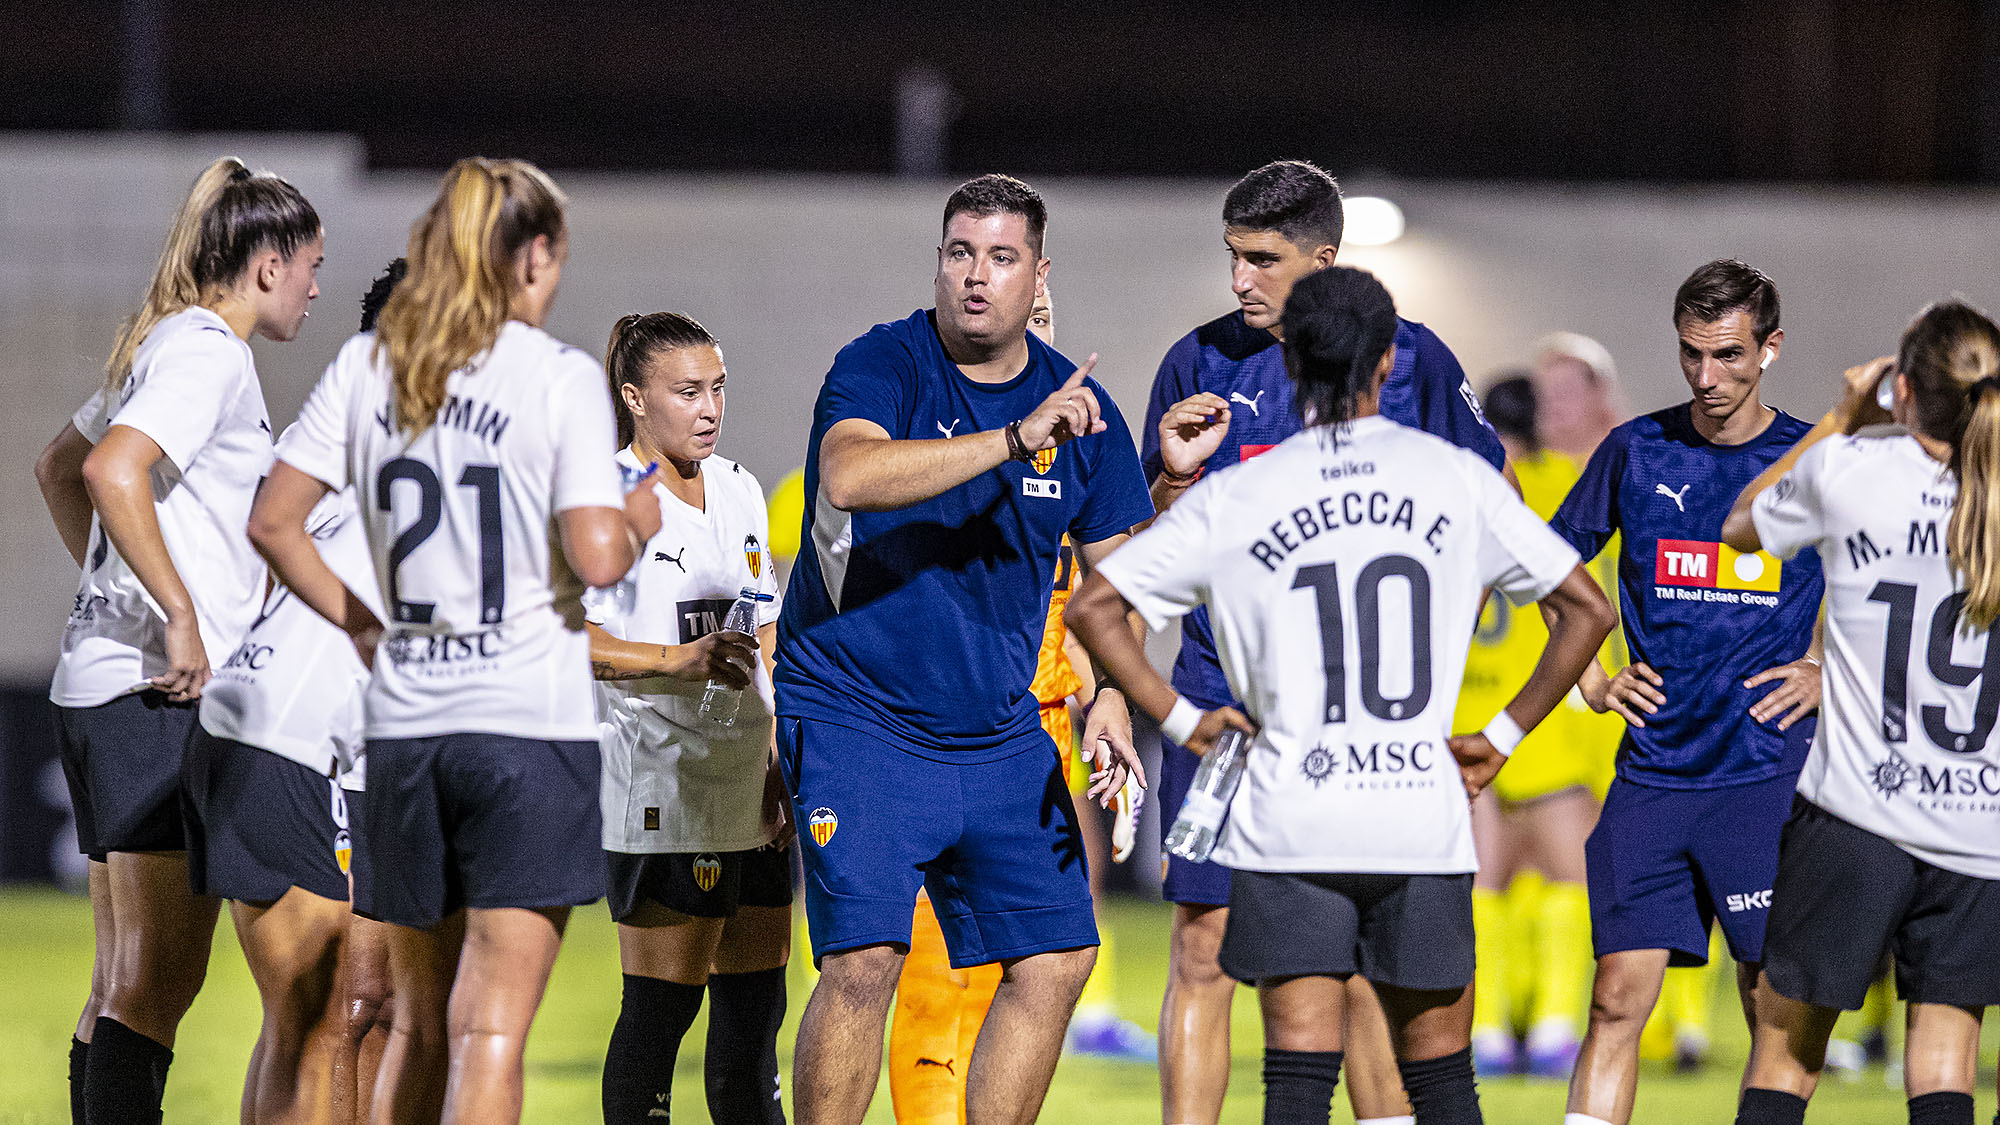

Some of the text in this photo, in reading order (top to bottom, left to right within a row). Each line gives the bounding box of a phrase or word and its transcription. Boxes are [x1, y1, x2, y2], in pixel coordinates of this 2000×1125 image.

[375, 396, 511, 445] YMIN
[1026, 482, 1040, 493] TM
[1320, 461, 1376, 481] teika
[377, 458, 504, 625] 21
[1250, 491, 1450, 572] REBECCA E.
[1664, 551, 1708, 578] TM
[1845, 528, 1892, 570] M.
[1654, 587, 1779, 608] TM Real Estate Group
[684, 611, 719, 636] TM
[1290, 554, 1432, 724] 10
[1867, 580, 2000, 753] 19
[1346, 741, 1433, 775] MSC
[1919, 765, 2000, 796] MSC
